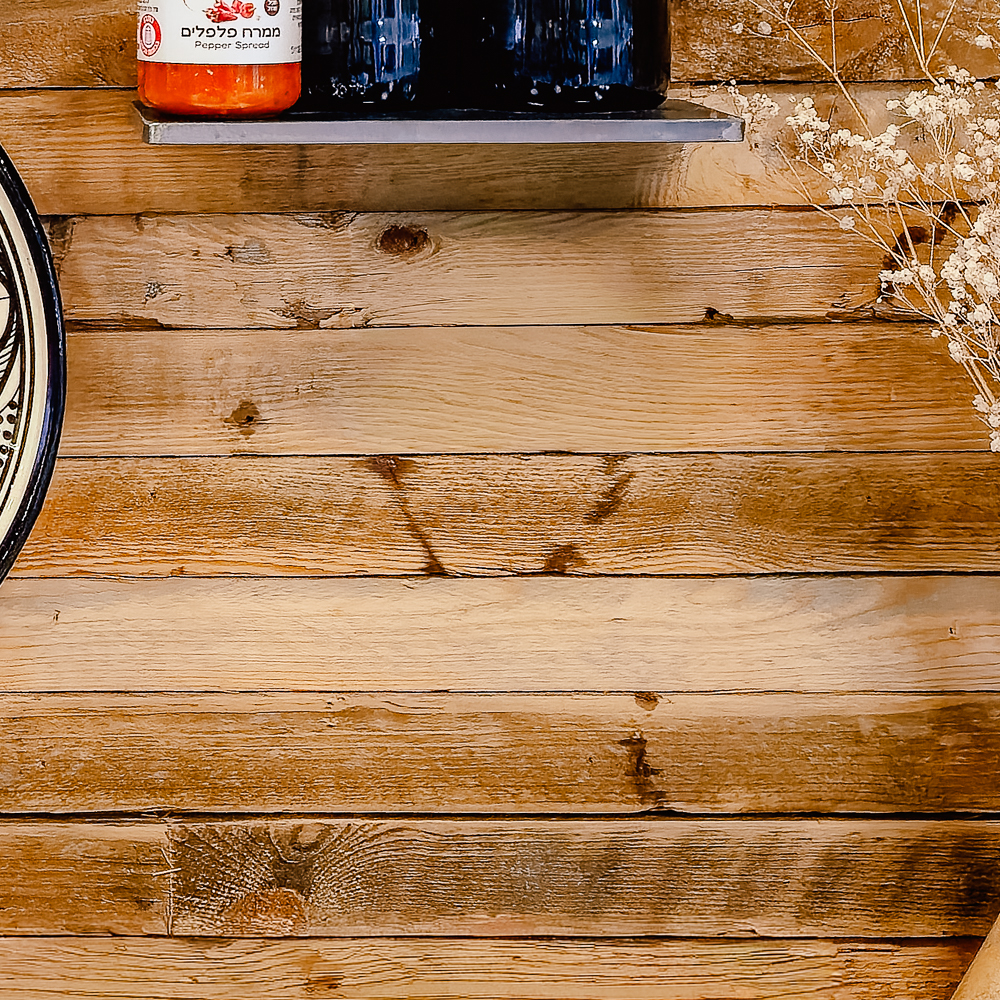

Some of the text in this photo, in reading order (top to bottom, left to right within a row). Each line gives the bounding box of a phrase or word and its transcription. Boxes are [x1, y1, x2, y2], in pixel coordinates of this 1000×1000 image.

[181, 25, 281, 38] ממרח פלפלים
[194, 40, 270, 51] Pepper Spread
